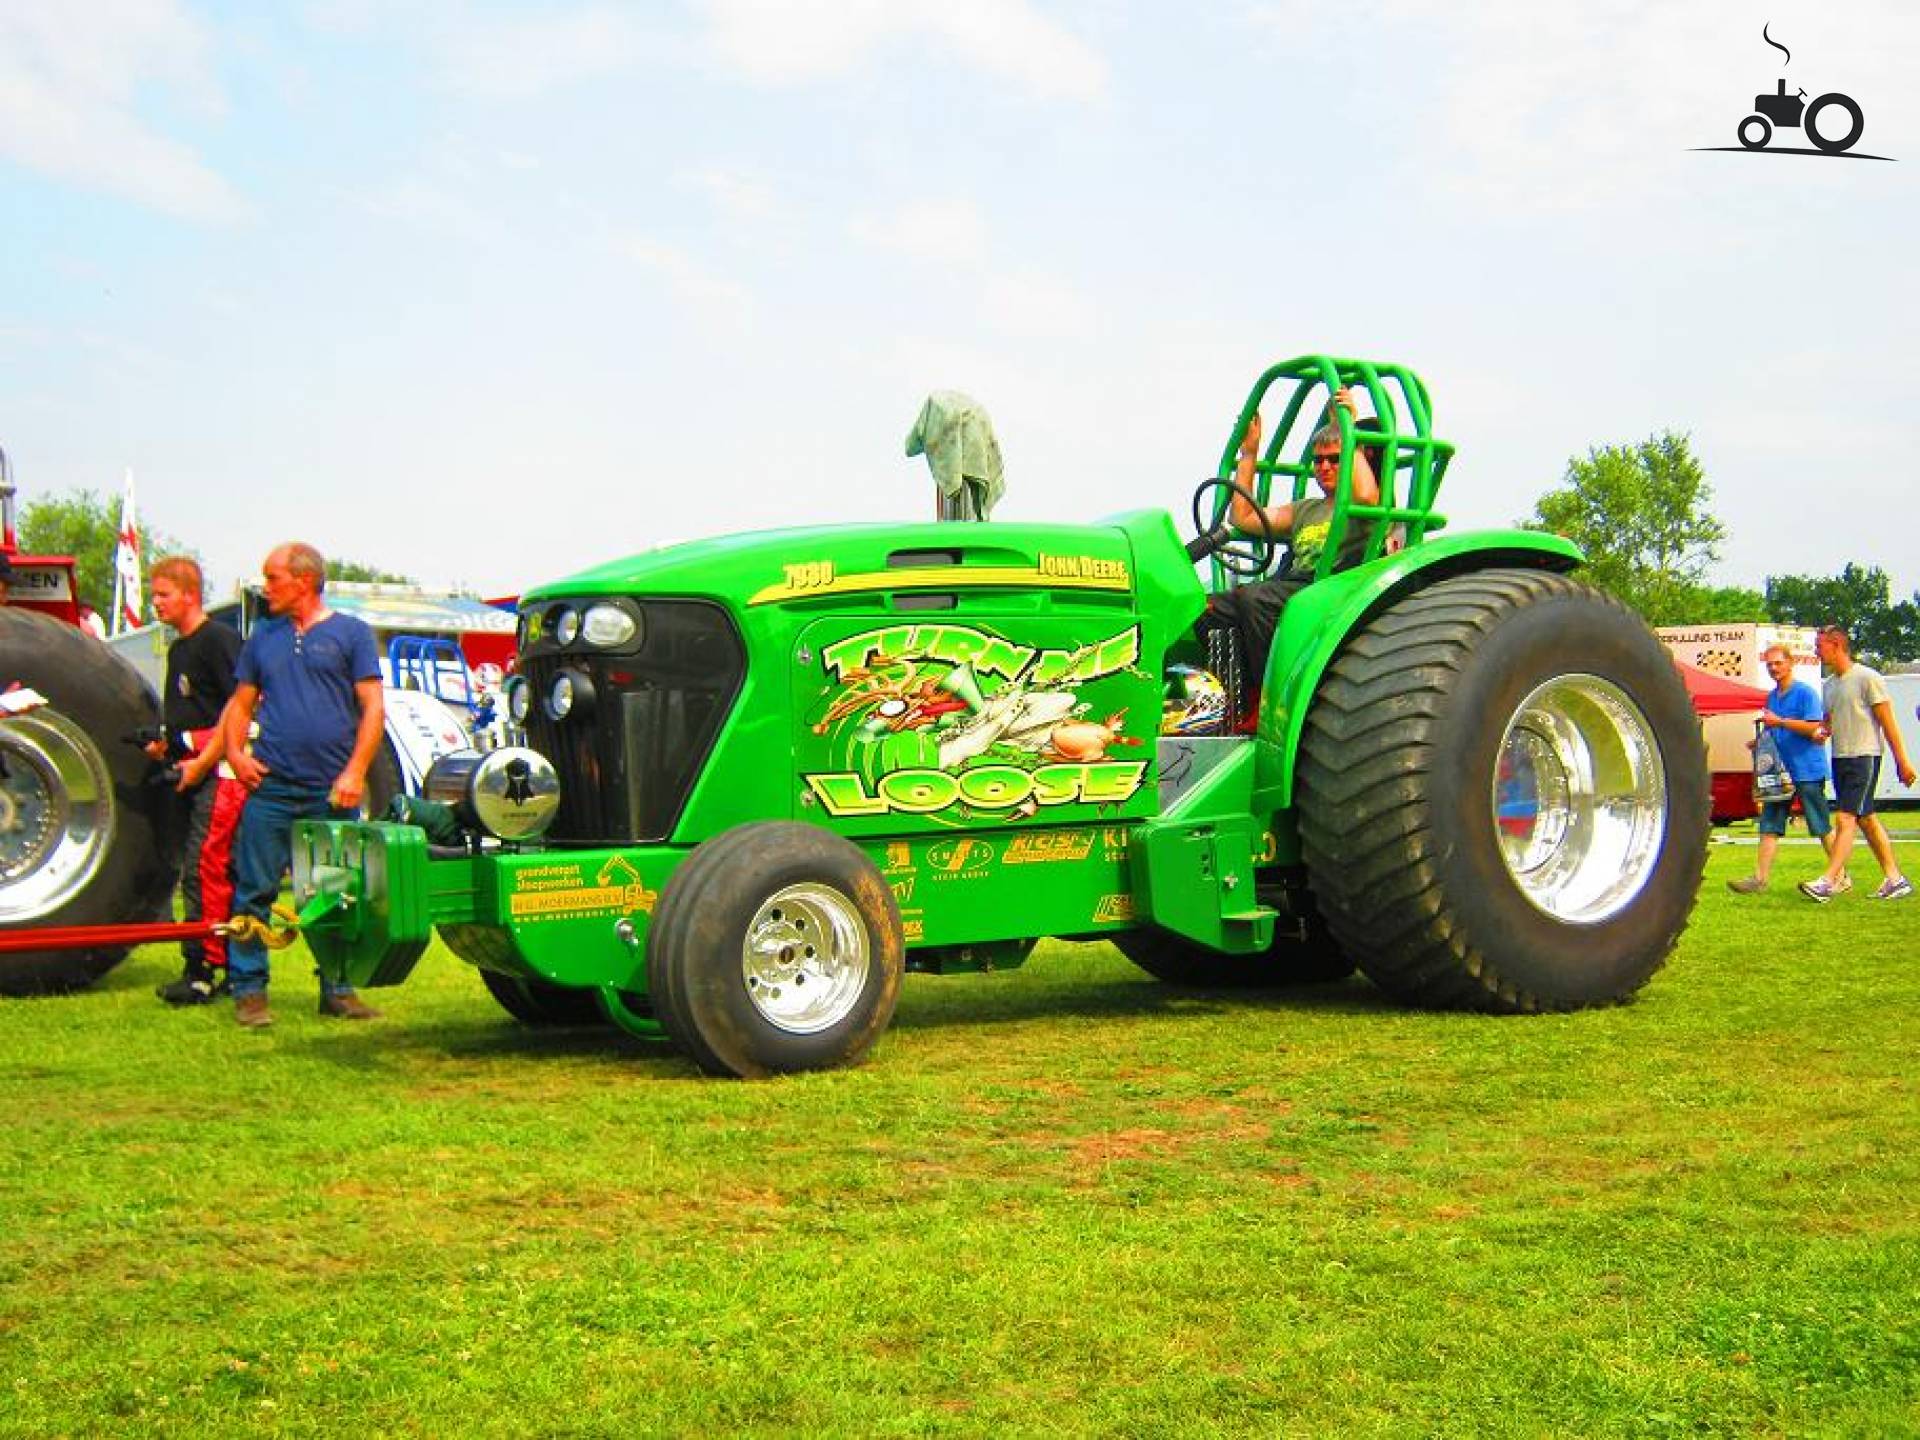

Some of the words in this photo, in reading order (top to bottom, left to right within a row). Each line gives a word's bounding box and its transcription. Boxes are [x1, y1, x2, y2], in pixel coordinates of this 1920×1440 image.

[1038, 551, 1078, 577] JOHN
[1079, 556, 1128, 580] DEERE
[823, 624, 1037, 683] TURN
[1030, 624, 1141, 684] ME
[1714, 630, 1745, 642] TEAM
[801, 761, 1149, 816] LOOSE
